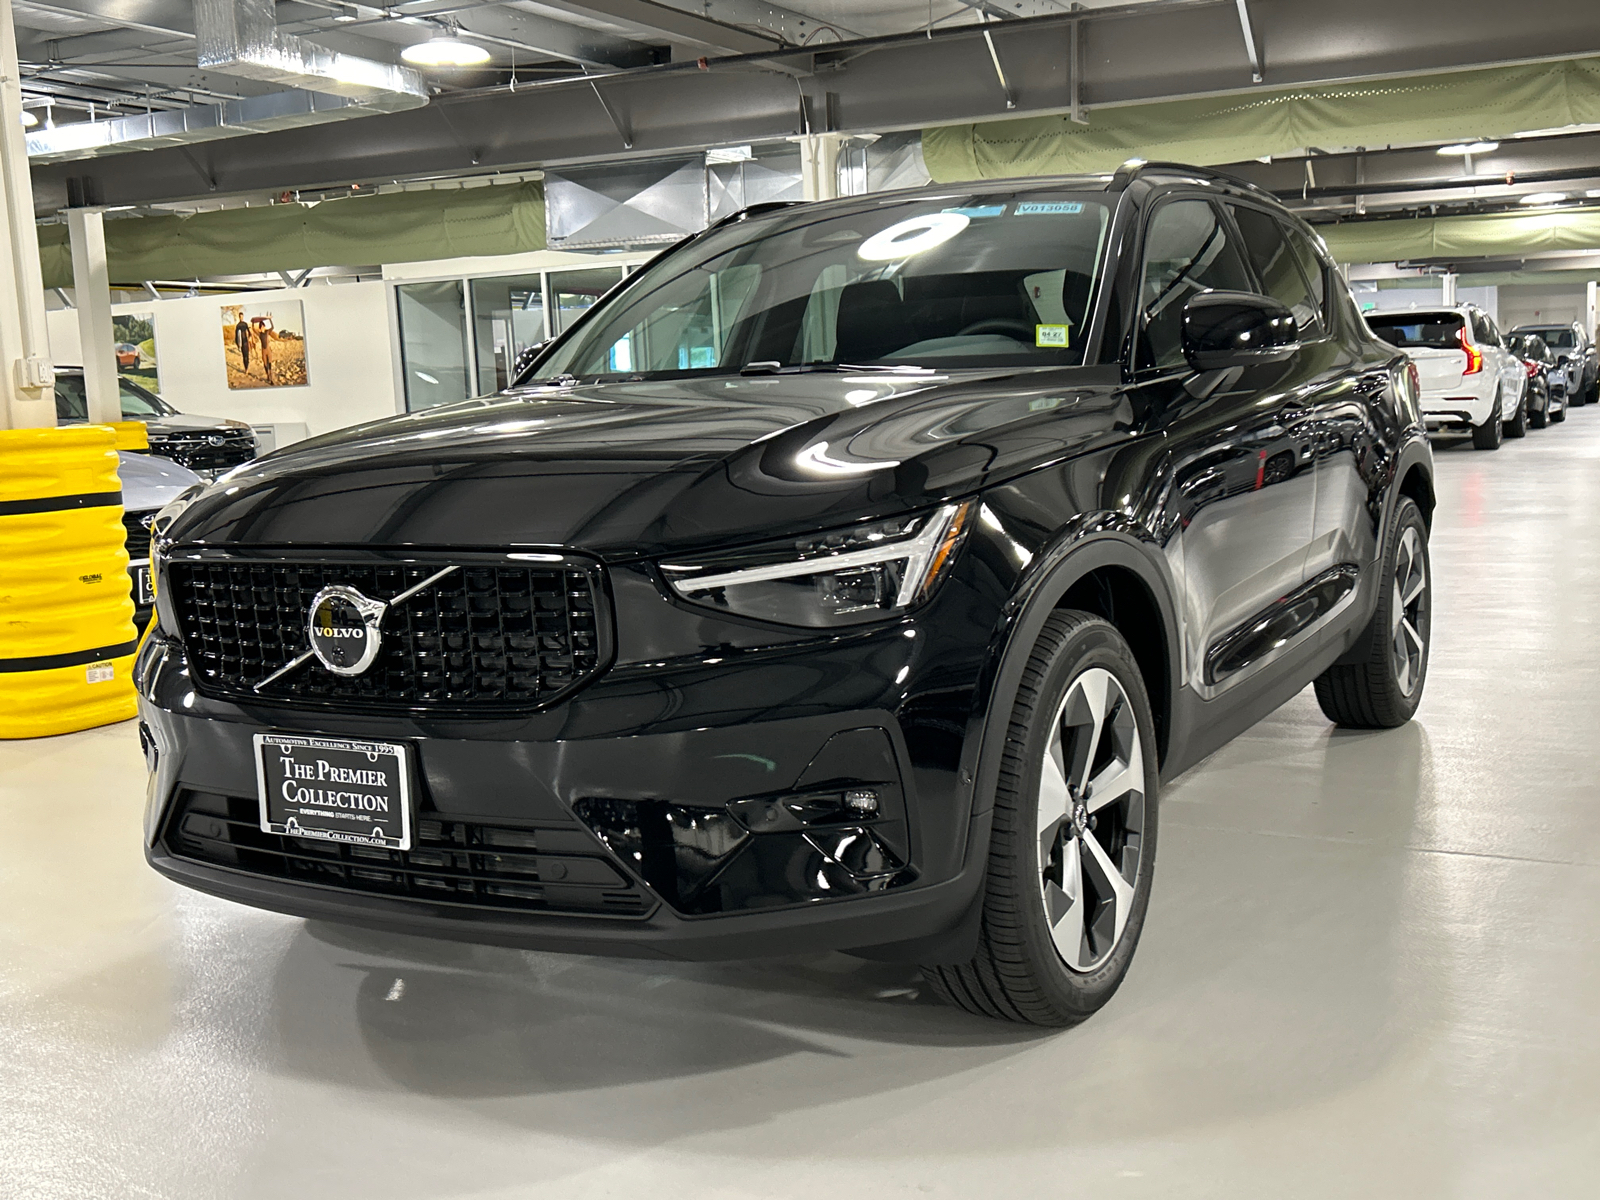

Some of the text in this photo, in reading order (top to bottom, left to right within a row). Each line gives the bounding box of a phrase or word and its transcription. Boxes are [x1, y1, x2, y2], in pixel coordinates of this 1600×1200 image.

[314, 627, 364, 639] VOLVO
[265, 736, 394, 754] AUTOMOTIVE EXCELLENCE SINCE 1995
[280, 756, 388, 787] THE PREMIER
[282, 780, 389, 812] COLLECTION
[299, 808, 335, 818] EVERYTHING
[335, 811, 356, 820] STARTS
